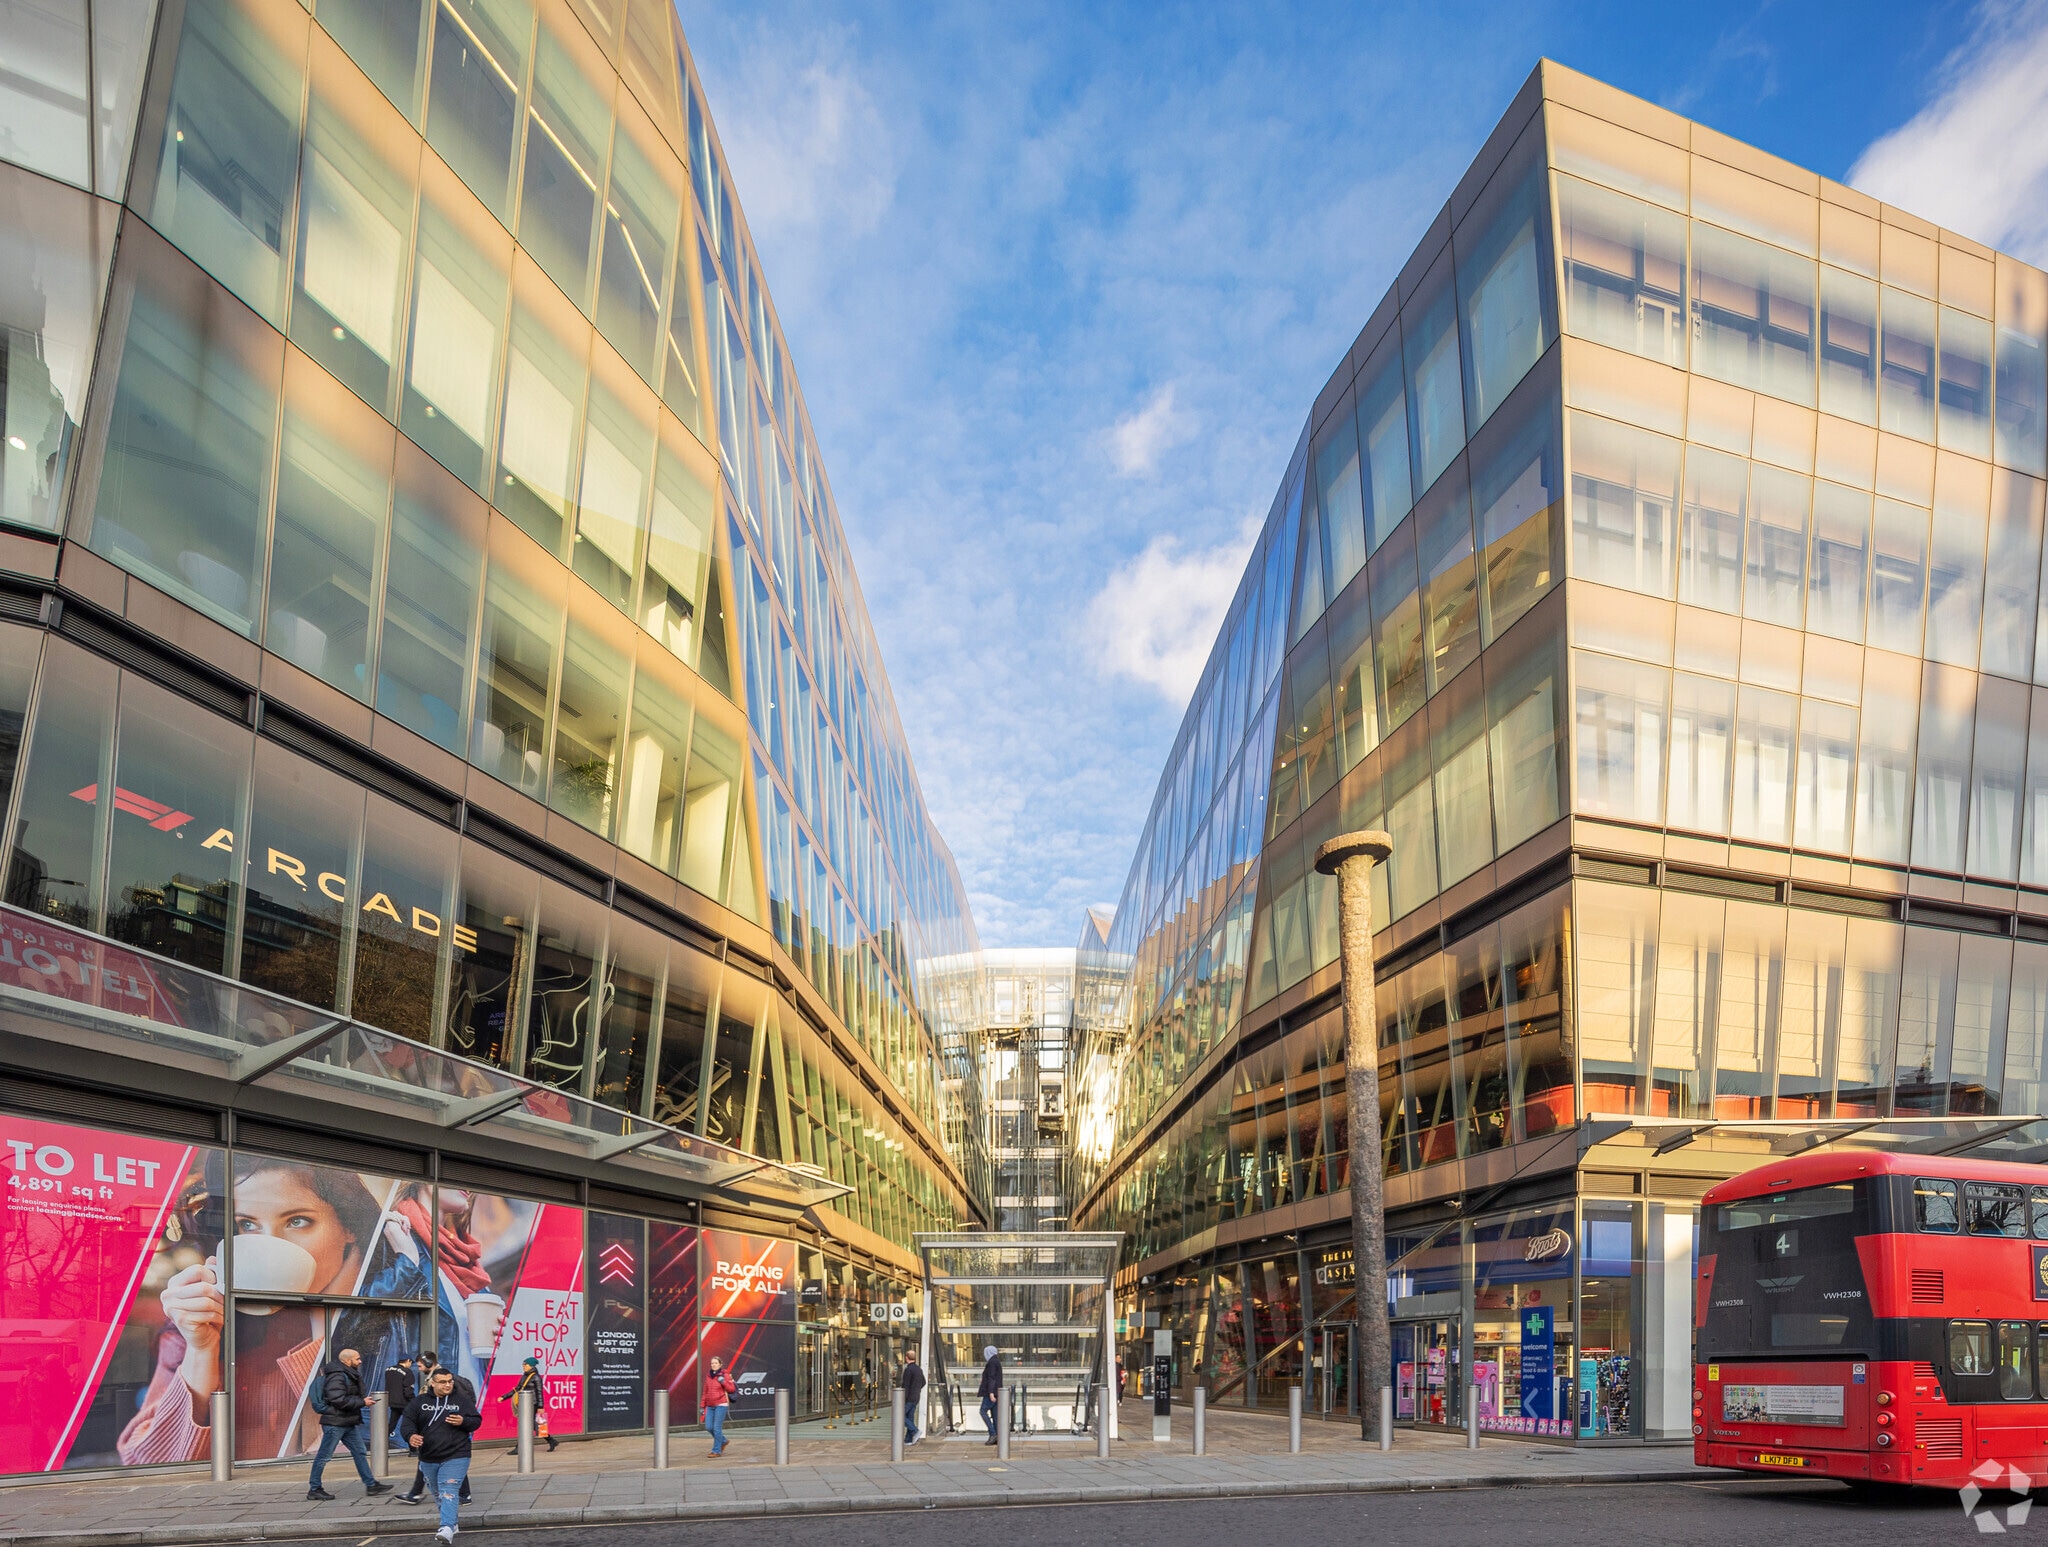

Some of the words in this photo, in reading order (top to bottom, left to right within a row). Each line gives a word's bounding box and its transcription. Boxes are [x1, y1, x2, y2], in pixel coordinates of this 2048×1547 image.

[201, 828, 477, 953] ARCADE
[7, 1139, 74, 1176] TO
[94, 1152, 161, 1188] LET
[7, 1175, 62, 1193] 4,891
[72, 1186, 93, 1200] sq
[99, 1186, 113, 1199] ft
[7, 1204, 35, 1212] contact
[36, 1206, 121, 1221] leasing@landsec.com
[22, 1197, 48, 1207] leasing
[50, 1201, 82, 1210] enquiries
[84, 1205, 106, 1213] please
[1526, 1232, 1560, 1260] Boots
[1776, 1233, 1790, 1254] 4
[1322, 1252, 1338, 1262] THE
[1342, 1250, 1354, 1259] IV
[716, 1260, 783, 1280] RACING
[711, 1276, 751, 1292] FOR
[754, 1281, 787, 1295] ALL
[1764, 1286, 1796, 1294] WRIGHT
[1715, 1299, 1744, 1307] VWH2308
[1823, 1291, 1862, 1300] VWH2308
[545, 1300, 579, 1320] EAT
[512, 1321, 569, 1342] SHOP
[597, 1331, 636, 1339] LONDON
[534, 1347, 579, 1367] PLAY
[553, 1381, 577, 1394] THE
[738, 1387, 775, 1396] RCADE
[549, 1396, 577, 1409] CITY
[1764, 1455, 1781, 1464] LK17
[1783, 1457, 1798, 1465] DFD
